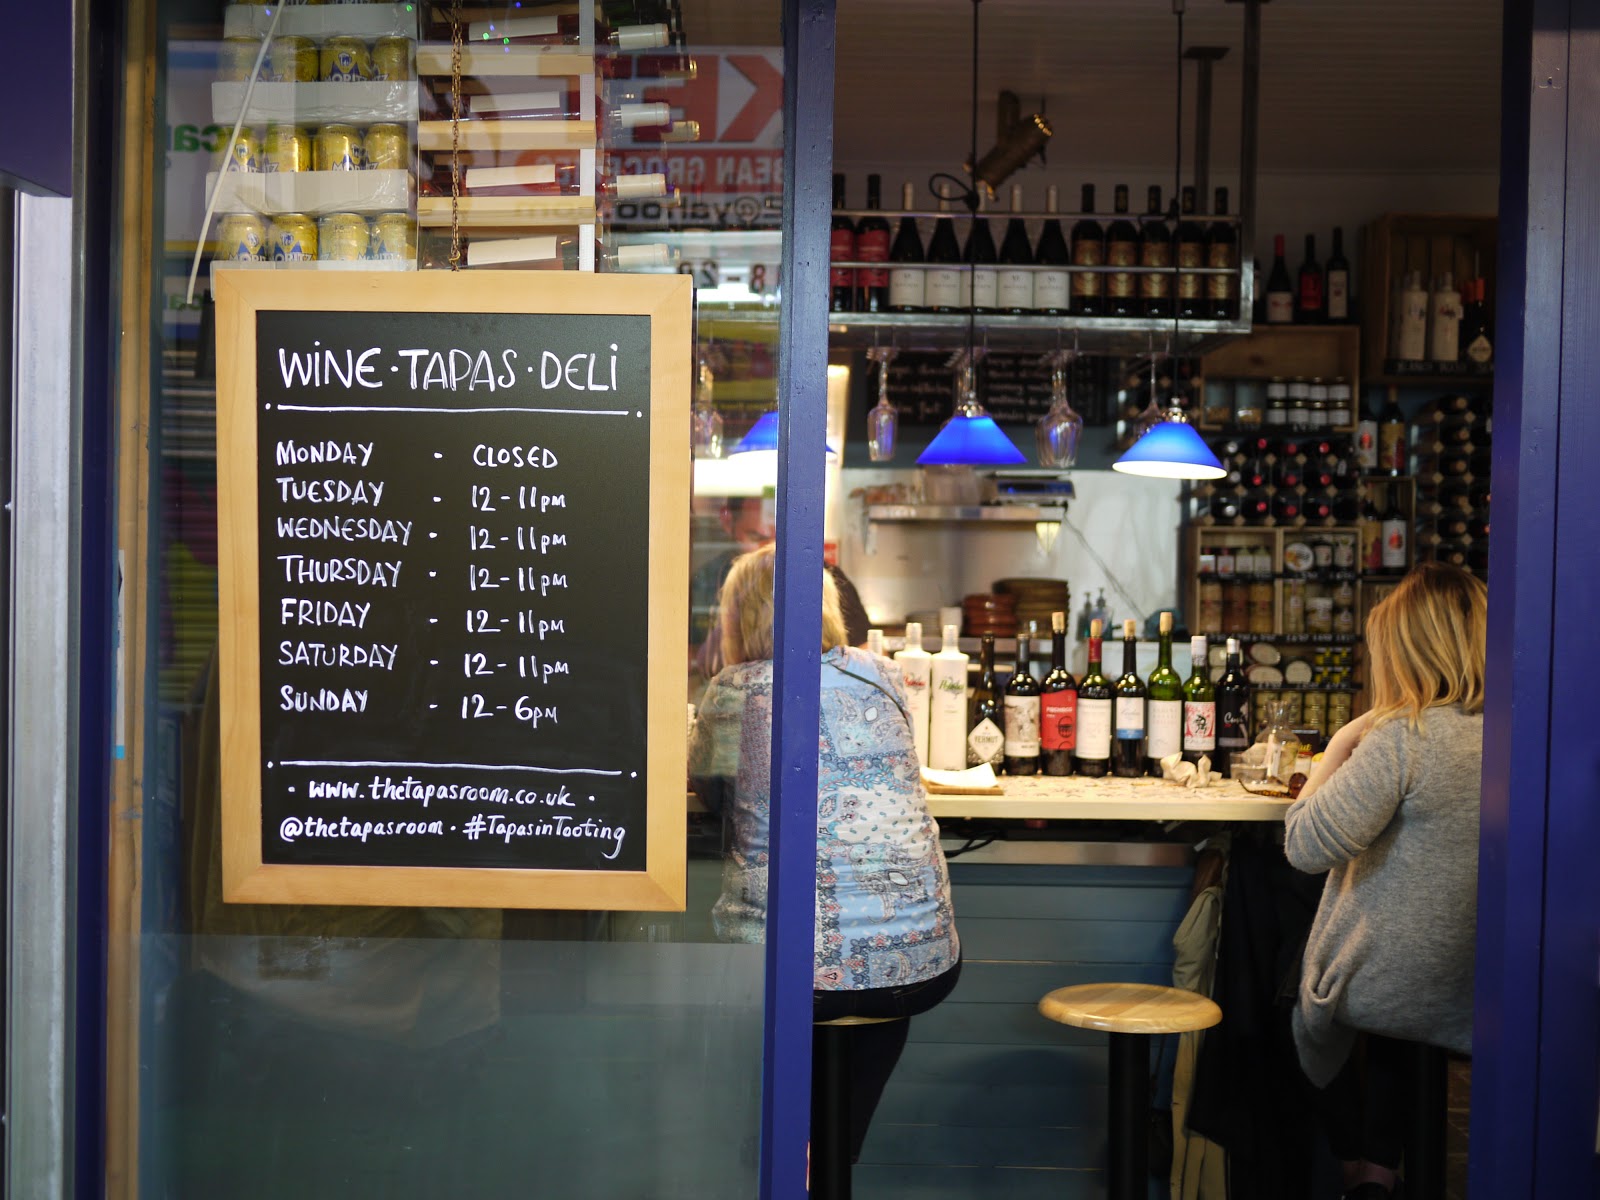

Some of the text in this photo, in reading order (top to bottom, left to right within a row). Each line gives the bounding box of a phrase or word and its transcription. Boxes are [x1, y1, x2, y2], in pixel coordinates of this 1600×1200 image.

[397, 348, 518, 393] TAPAS
[276, 440, 559, 469] MONDAY CLOSED
[275, 476, 385, 507] TUESDAY
[277, 515, 413, 547] WEDNESDAY
[276, 554, 402, 588] THURSDAY
[281, 597, 371, 629] FRIDAY
[278, 640, 398, 671] SATURDAY
[279, 684, 368, 713] SUNDAY
[279, 813, 627, 860] @thetapasroom #TapasinTooting
